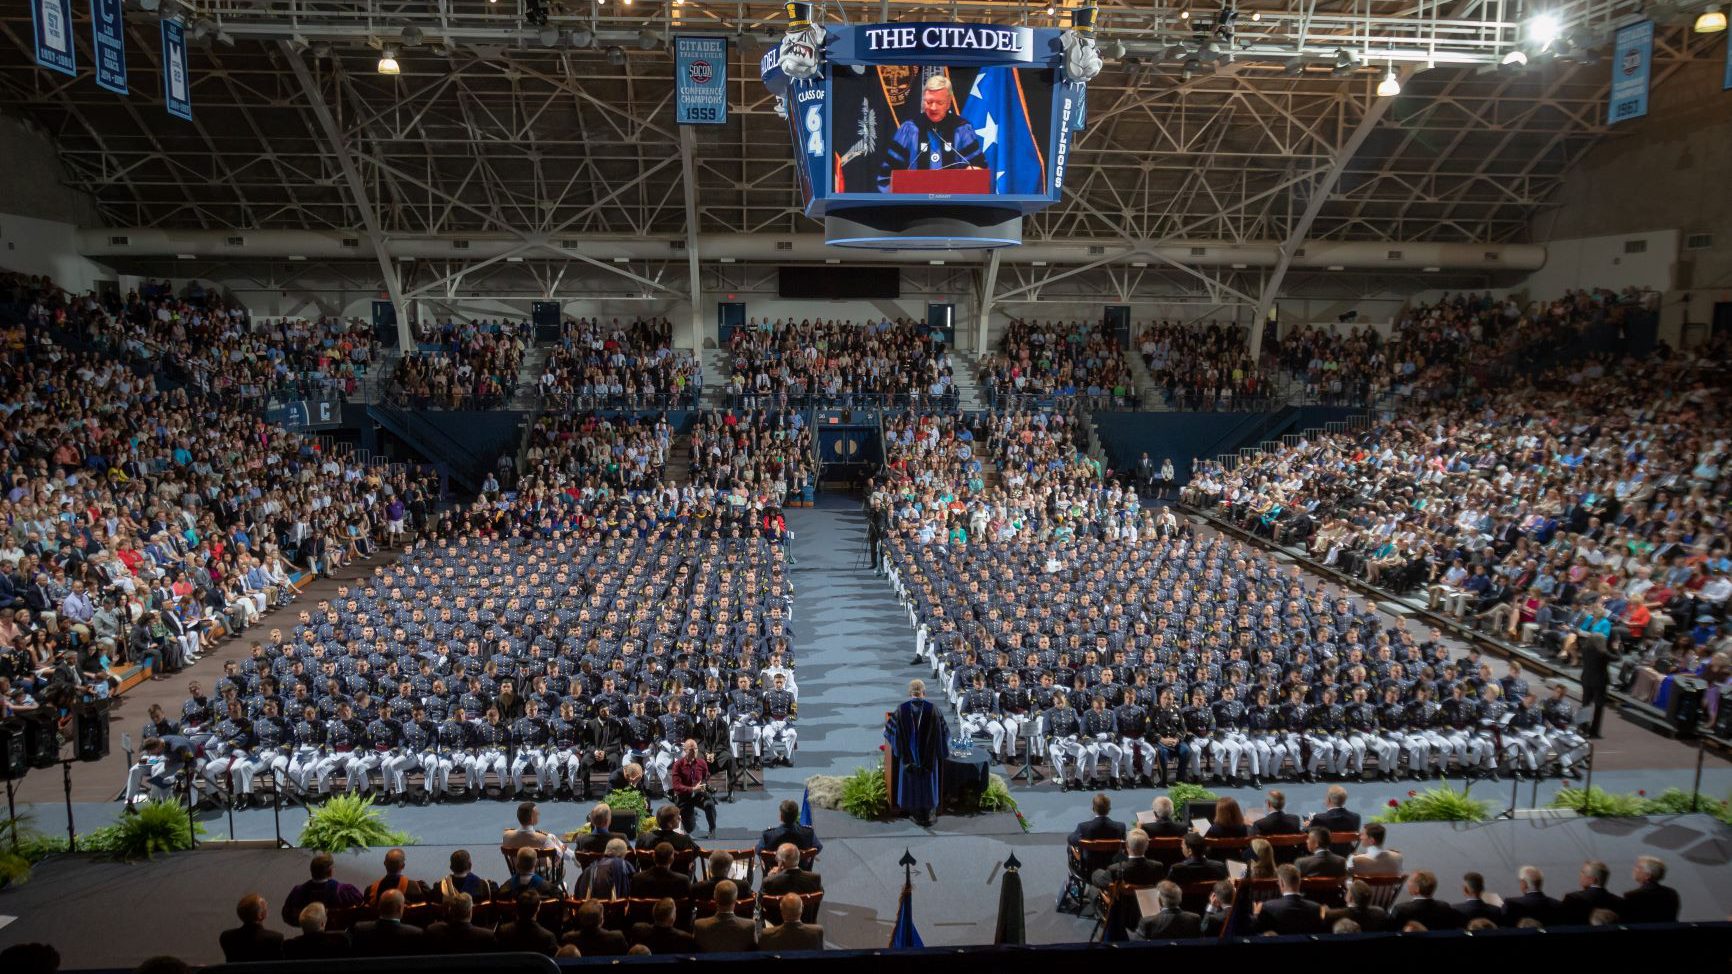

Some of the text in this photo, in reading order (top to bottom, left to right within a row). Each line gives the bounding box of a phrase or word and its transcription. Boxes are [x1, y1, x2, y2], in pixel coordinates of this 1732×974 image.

[866, 28, 1024, 51] THE CITADEL
[680, 41, 722, 51] CITADEL
[689, 64, 713, 78] SOCON
[680, 87, 722, 96] CONFERENCE
[798, 90, 825, 102] CLASS OF
[681, 95, 722, 104] CHAMPIONS
[687, 107, 716, 120] 1959
[1055, 98, 1072, 188] BULLDOGS
